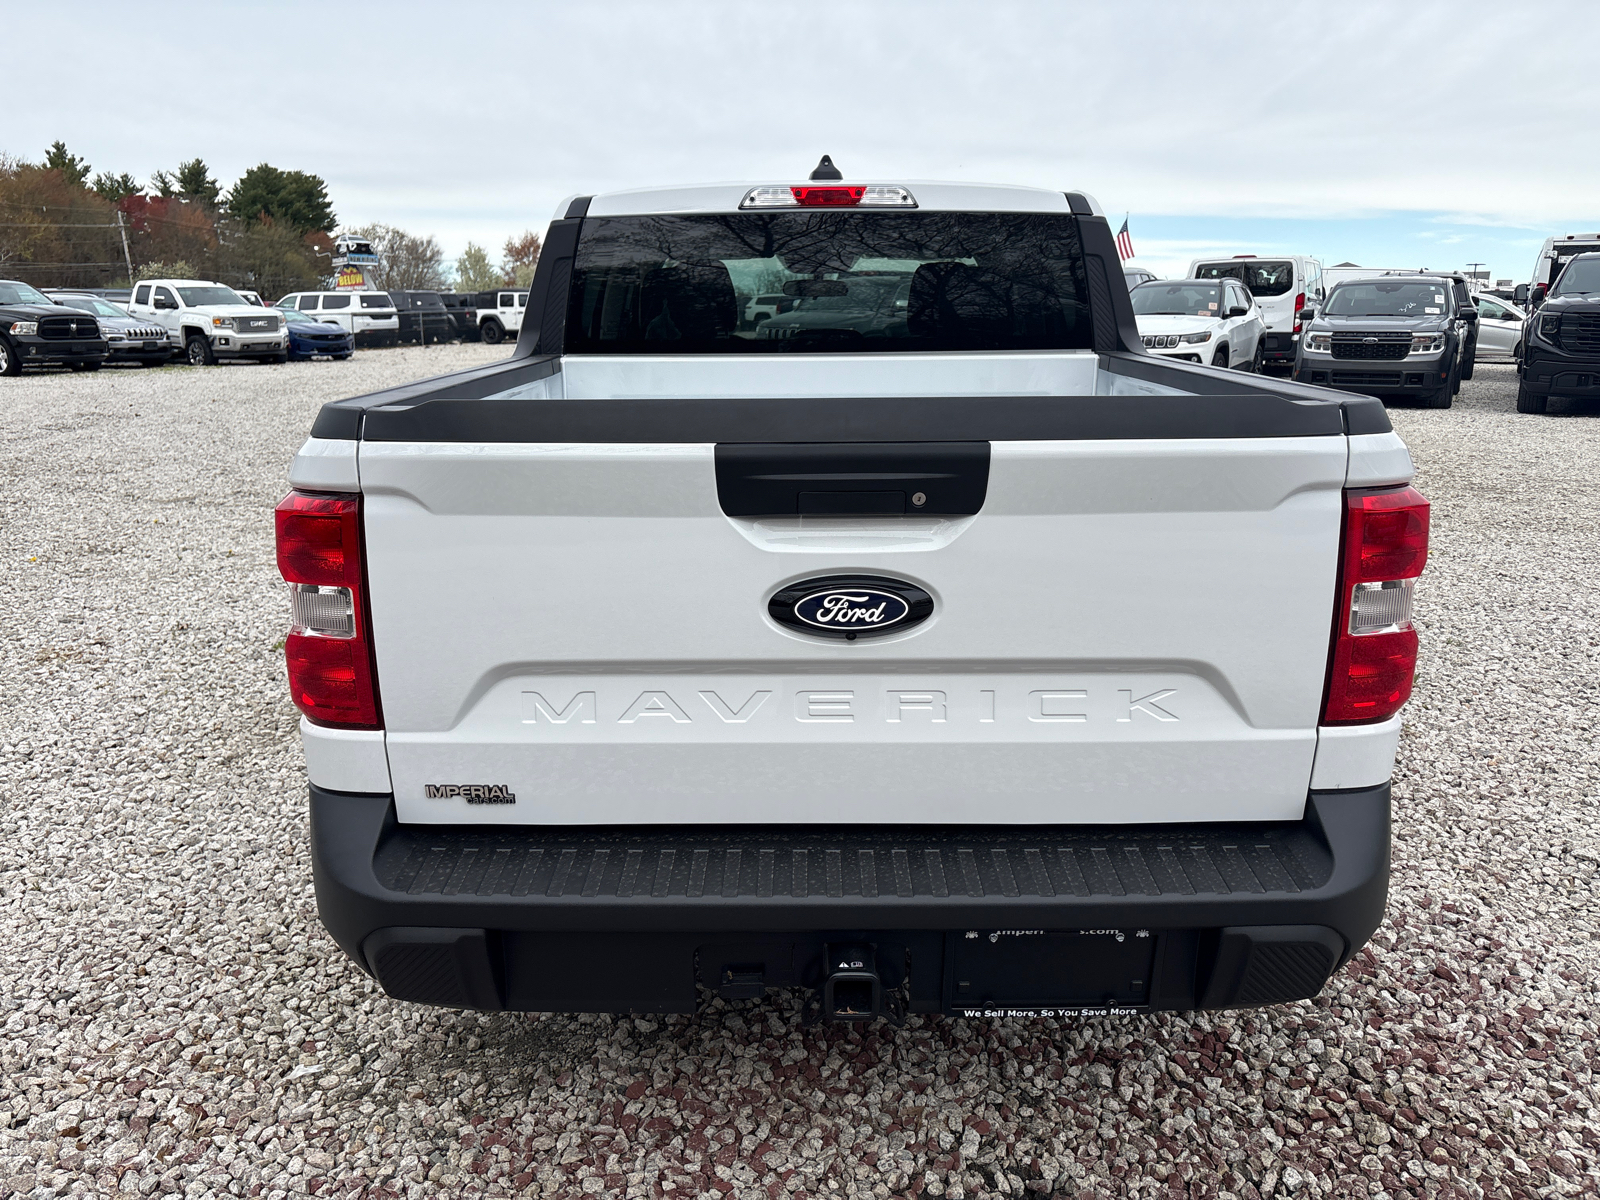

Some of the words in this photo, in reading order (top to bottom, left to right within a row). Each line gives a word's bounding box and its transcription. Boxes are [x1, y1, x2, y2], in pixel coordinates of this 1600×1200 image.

[338, 274, 363, 287] BELOW
[816, 594, 887, 623] Ford
[520, 689, 1181, 726] MAVERICK
[424, 784, 516, 799] IMPERIAL
[465, 796, 517, 805] cars.com
[964, 1009, 982, 1018] We
[984, 1009, 1004, 1018] Sell
[1007, 1009, 1038, 1019] More,
[1040, 1008, 1055, 1018] So
[1058, 1008, 1079, 1017] You
[1081, 1008, 1107, 1017] Save
[1110, 1007, 1138, 1016] More
